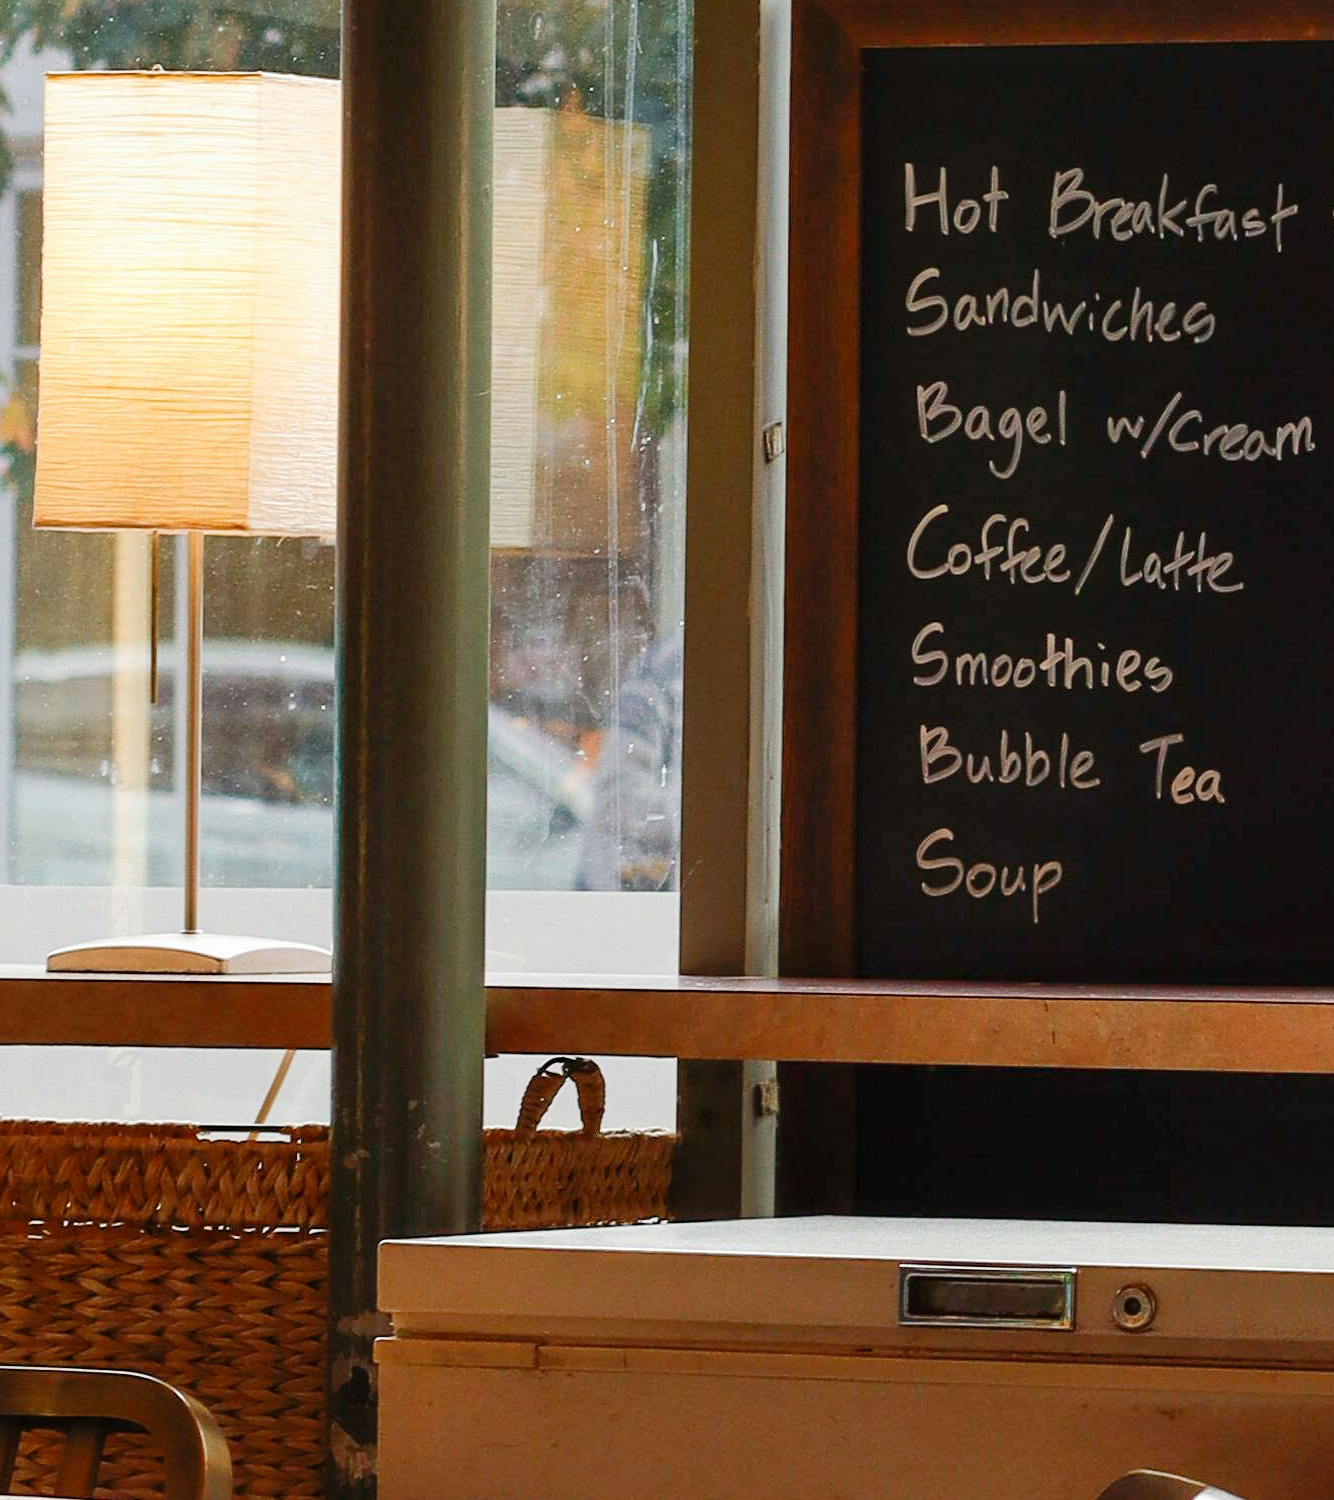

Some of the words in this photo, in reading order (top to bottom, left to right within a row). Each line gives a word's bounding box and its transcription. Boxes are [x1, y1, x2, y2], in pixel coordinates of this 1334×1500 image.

[903, 162, 1010, 237] Hot
[1047, 166, 1299, 254] Breakfast
[905, 267, 1216, 344] Sandwiches
[915, 380, 1066, 480] Bagel
[906, 503, 1244, 596] Coffee/Latte
[911, 621, 1174, 693] Smoothies
[919, 724, 1101, 789] Bubble
[1139, 733, 1226, 805] Tea
[915, 827, 1063, 924] Soup
